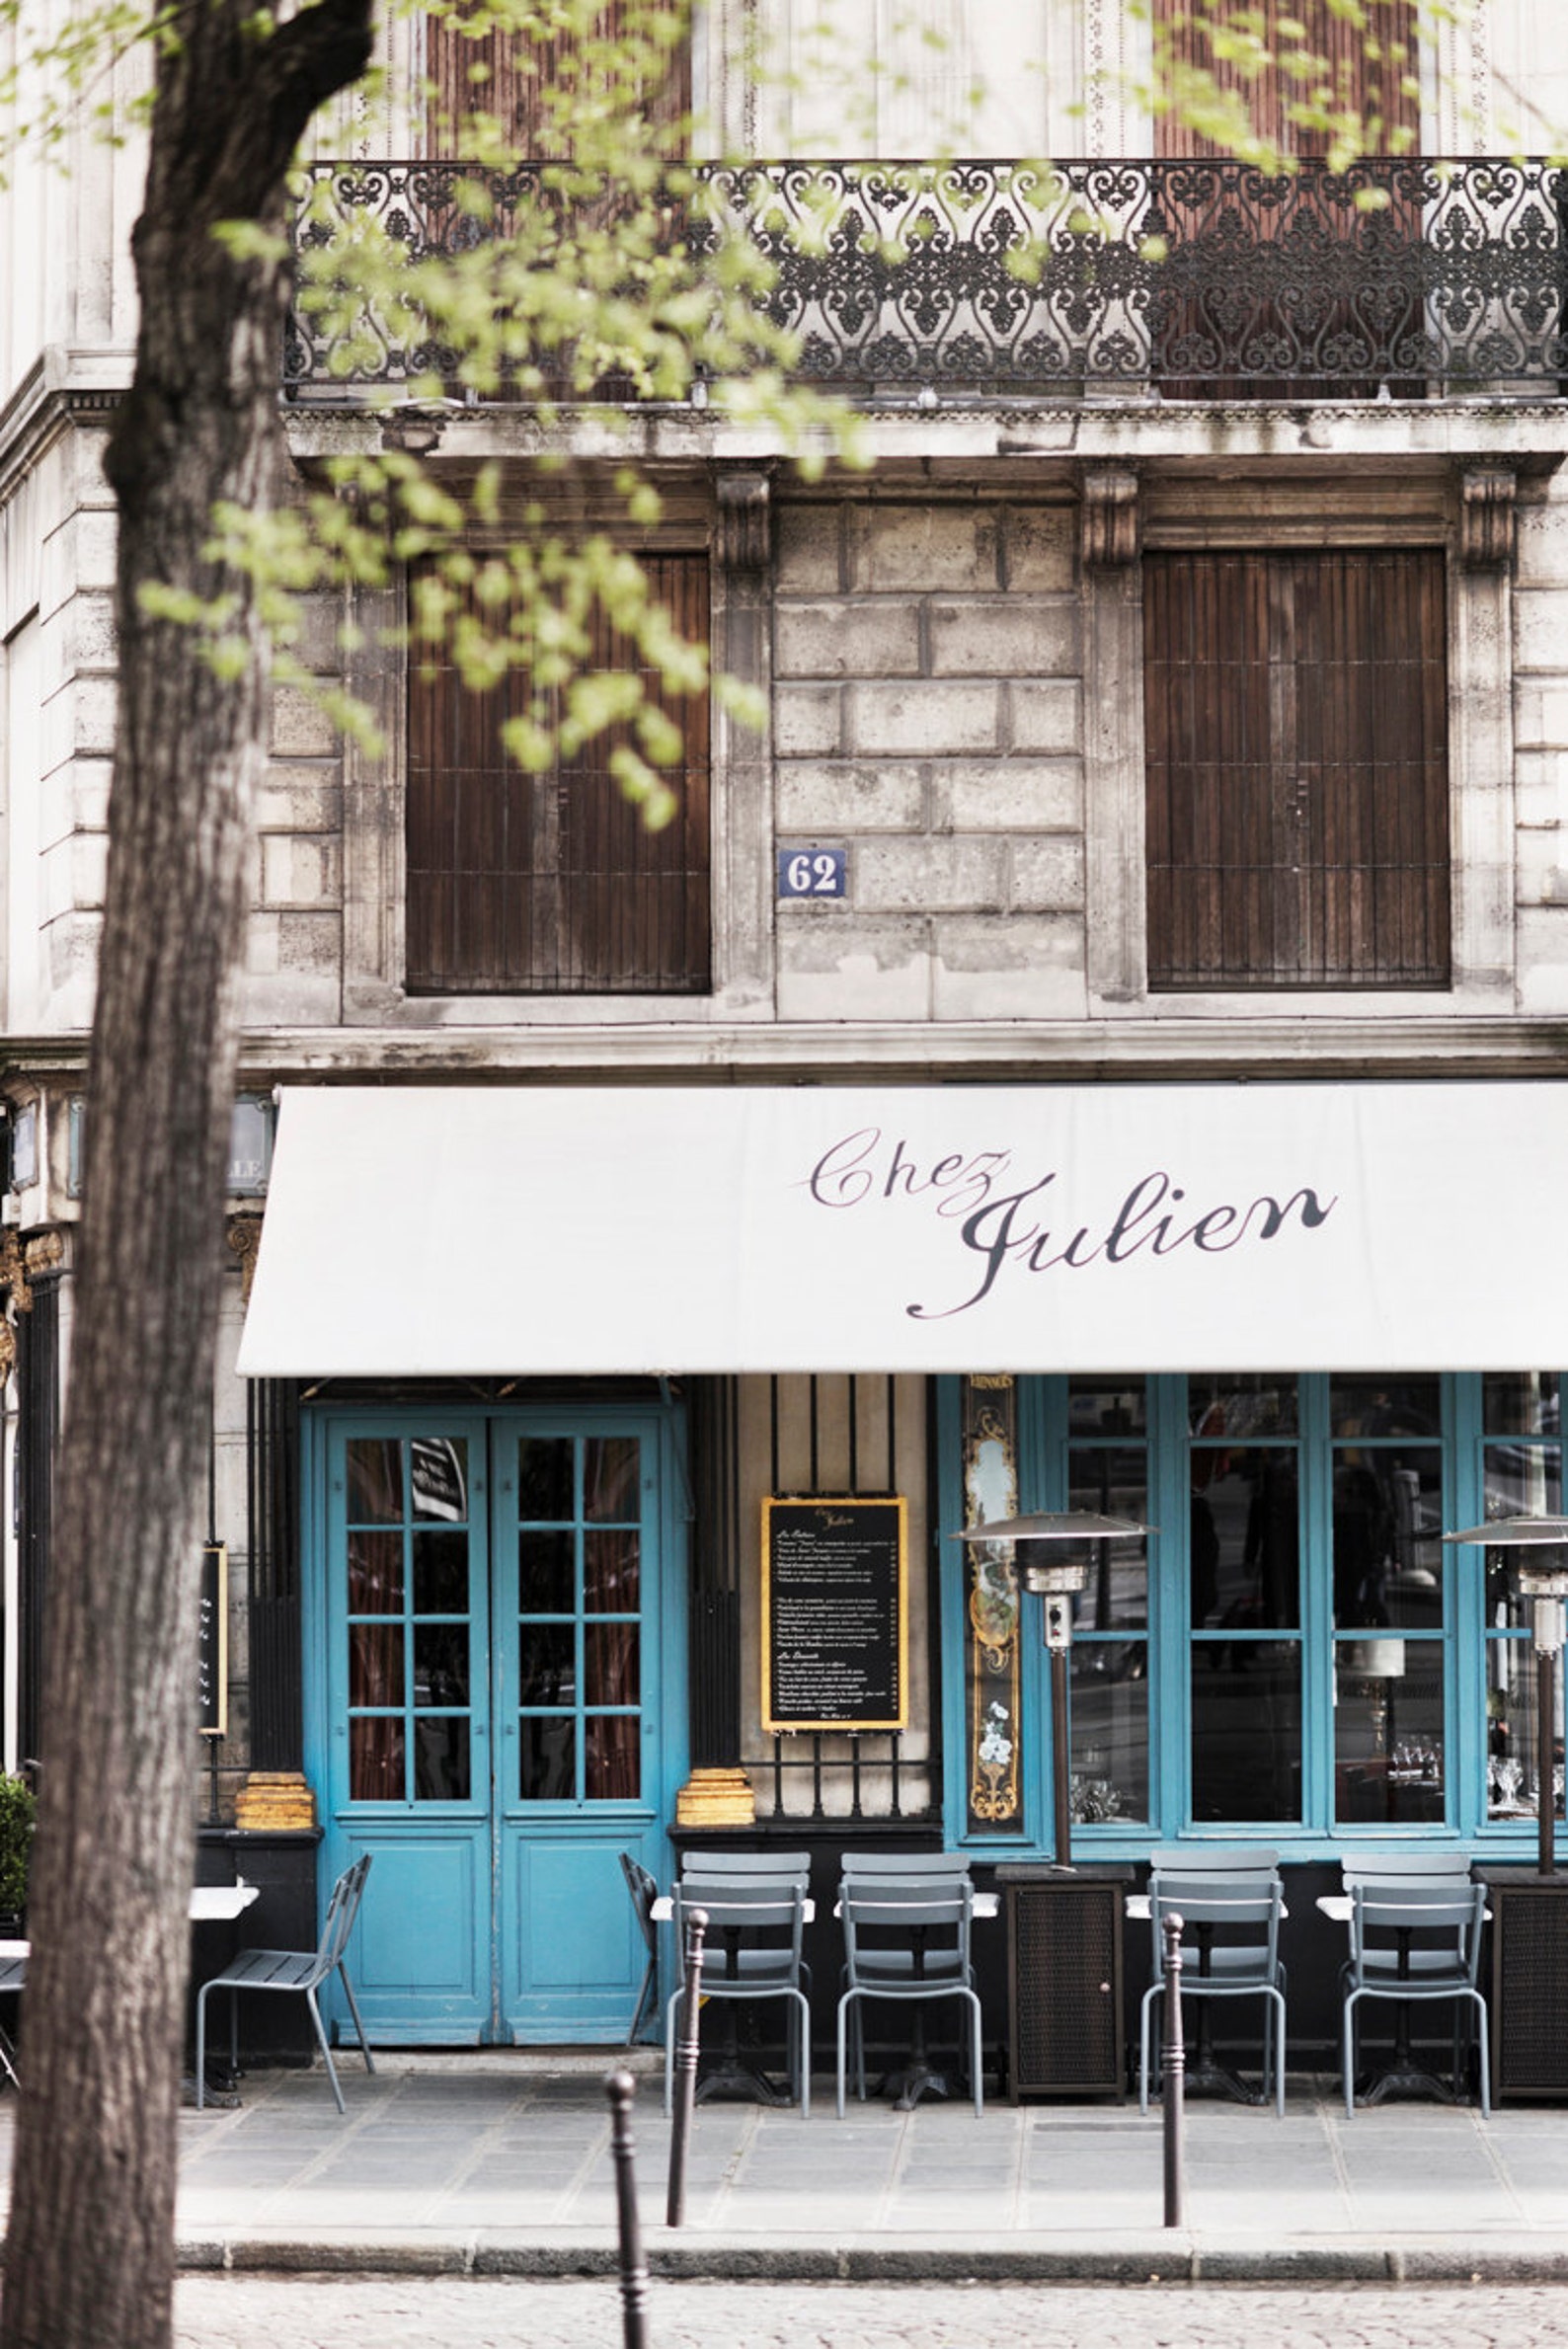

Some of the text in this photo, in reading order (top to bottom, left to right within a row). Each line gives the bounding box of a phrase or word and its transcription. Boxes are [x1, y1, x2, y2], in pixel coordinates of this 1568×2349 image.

[788, 855, 836, 891] 62
[791, 1127, 1012, 1218] Chez
[905, 1171, 1339, 1321] Julien
